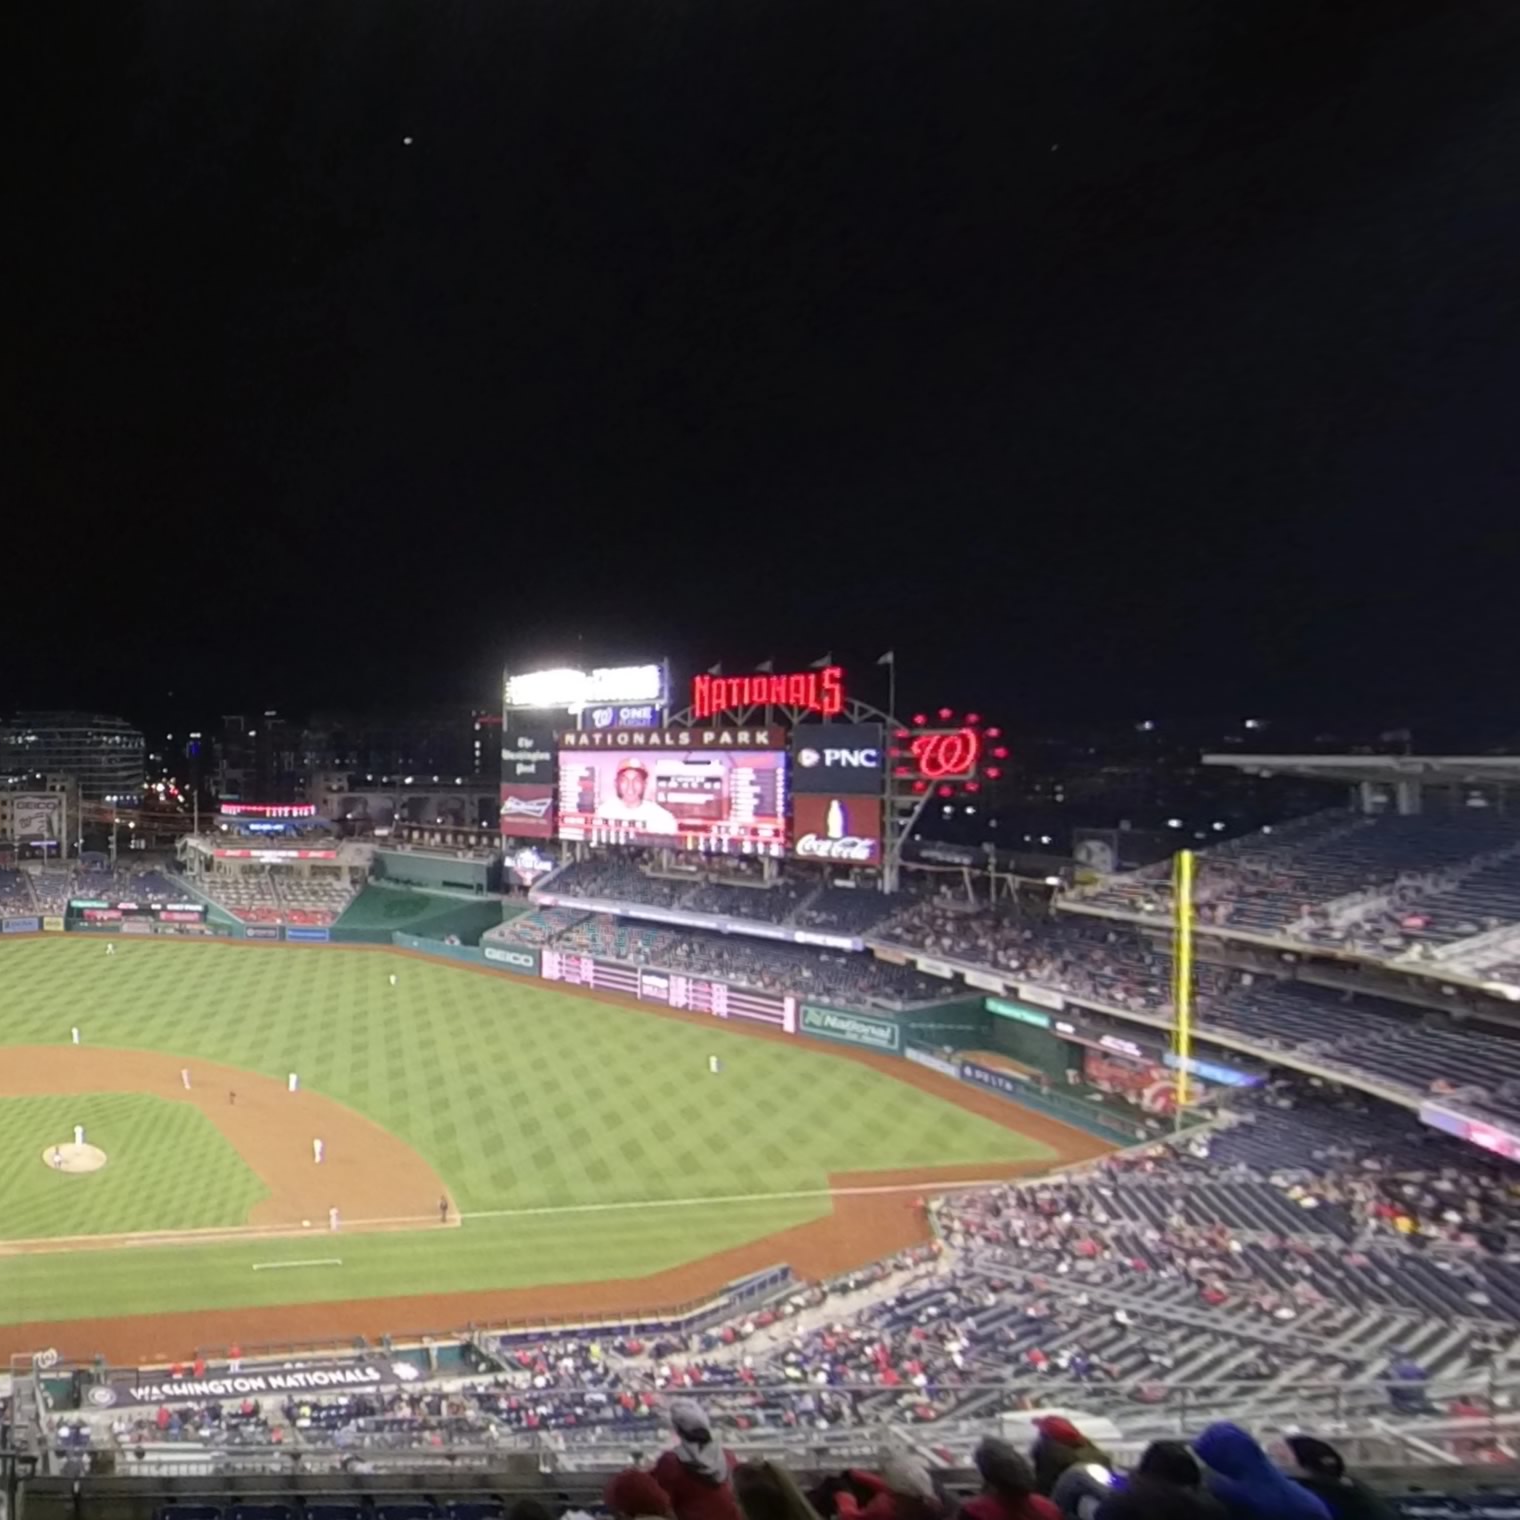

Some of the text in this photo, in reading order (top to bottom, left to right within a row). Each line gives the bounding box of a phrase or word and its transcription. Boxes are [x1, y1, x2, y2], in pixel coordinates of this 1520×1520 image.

[693, 665, 843, 719] NATIONALS
[619, 706, 651, 719] ONE
[564, 730, 769, 746] NATIONALS PARK
[823, 748, 877, 768] PNC
[911, 727, 978, 777] W
[484, 947, 534, 968] GEICO
[823, 1014, 891, 1040] National
[974, 1069, 1013, 1092] DELTA
[130, 1366, 381, 1400] WASHINGTON NATIONALS
